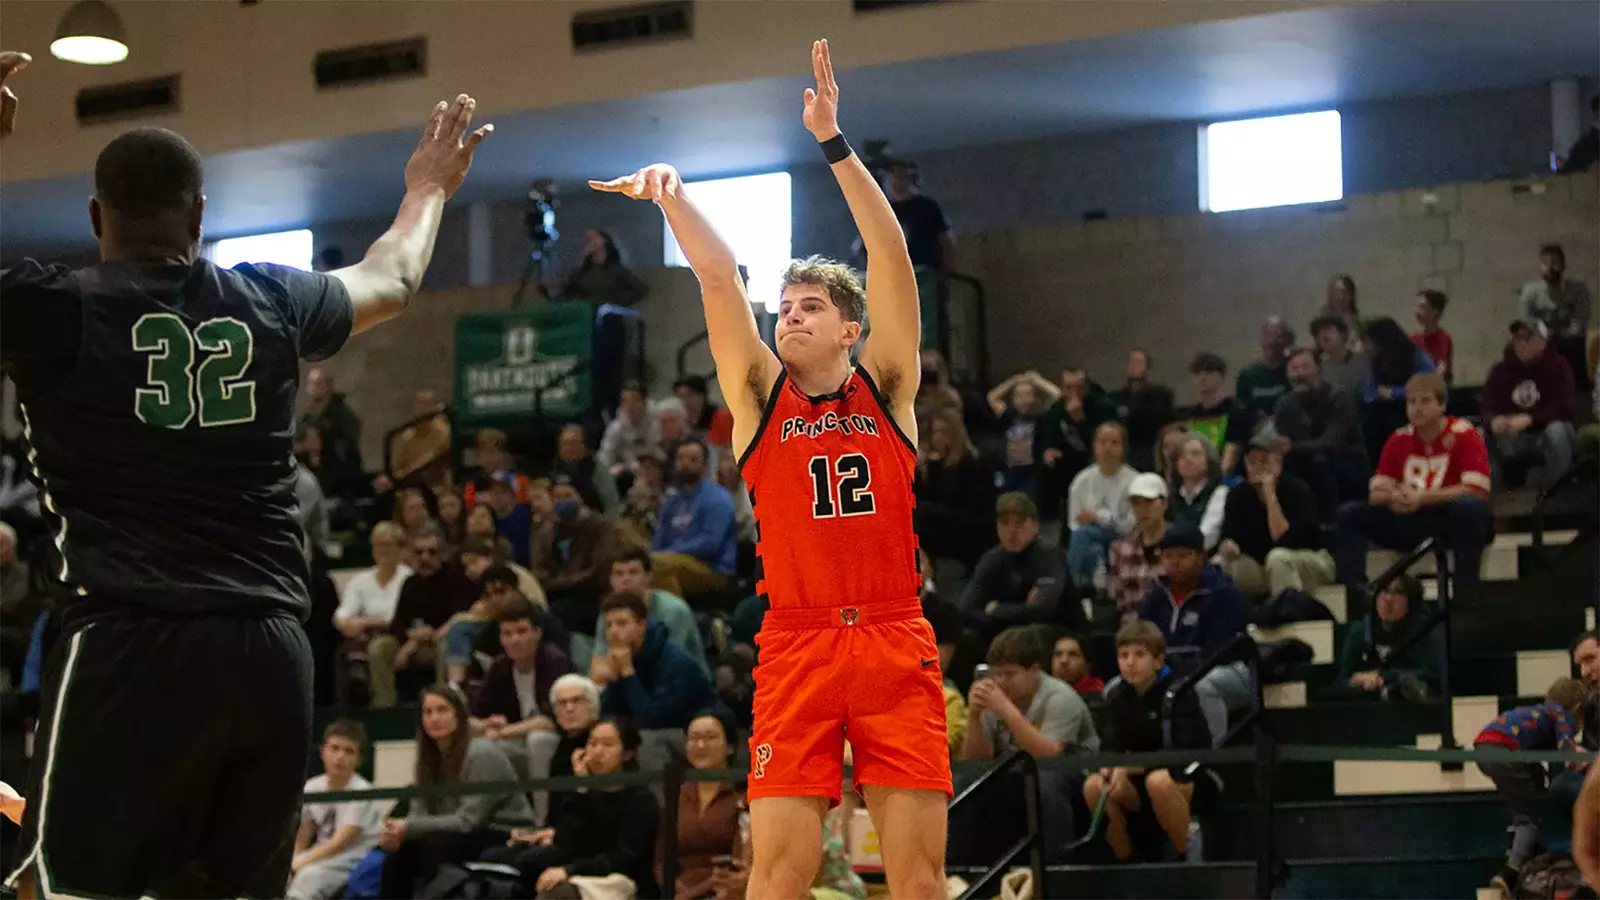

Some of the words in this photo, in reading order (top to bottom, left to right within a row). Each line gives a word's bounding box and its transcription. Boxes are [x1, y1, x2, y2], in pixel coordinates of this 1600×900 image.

[131, 313, 256, 429] 32
[781, 411, 880, 443] PRINCTON
[808, 452, 876, 519] 12
